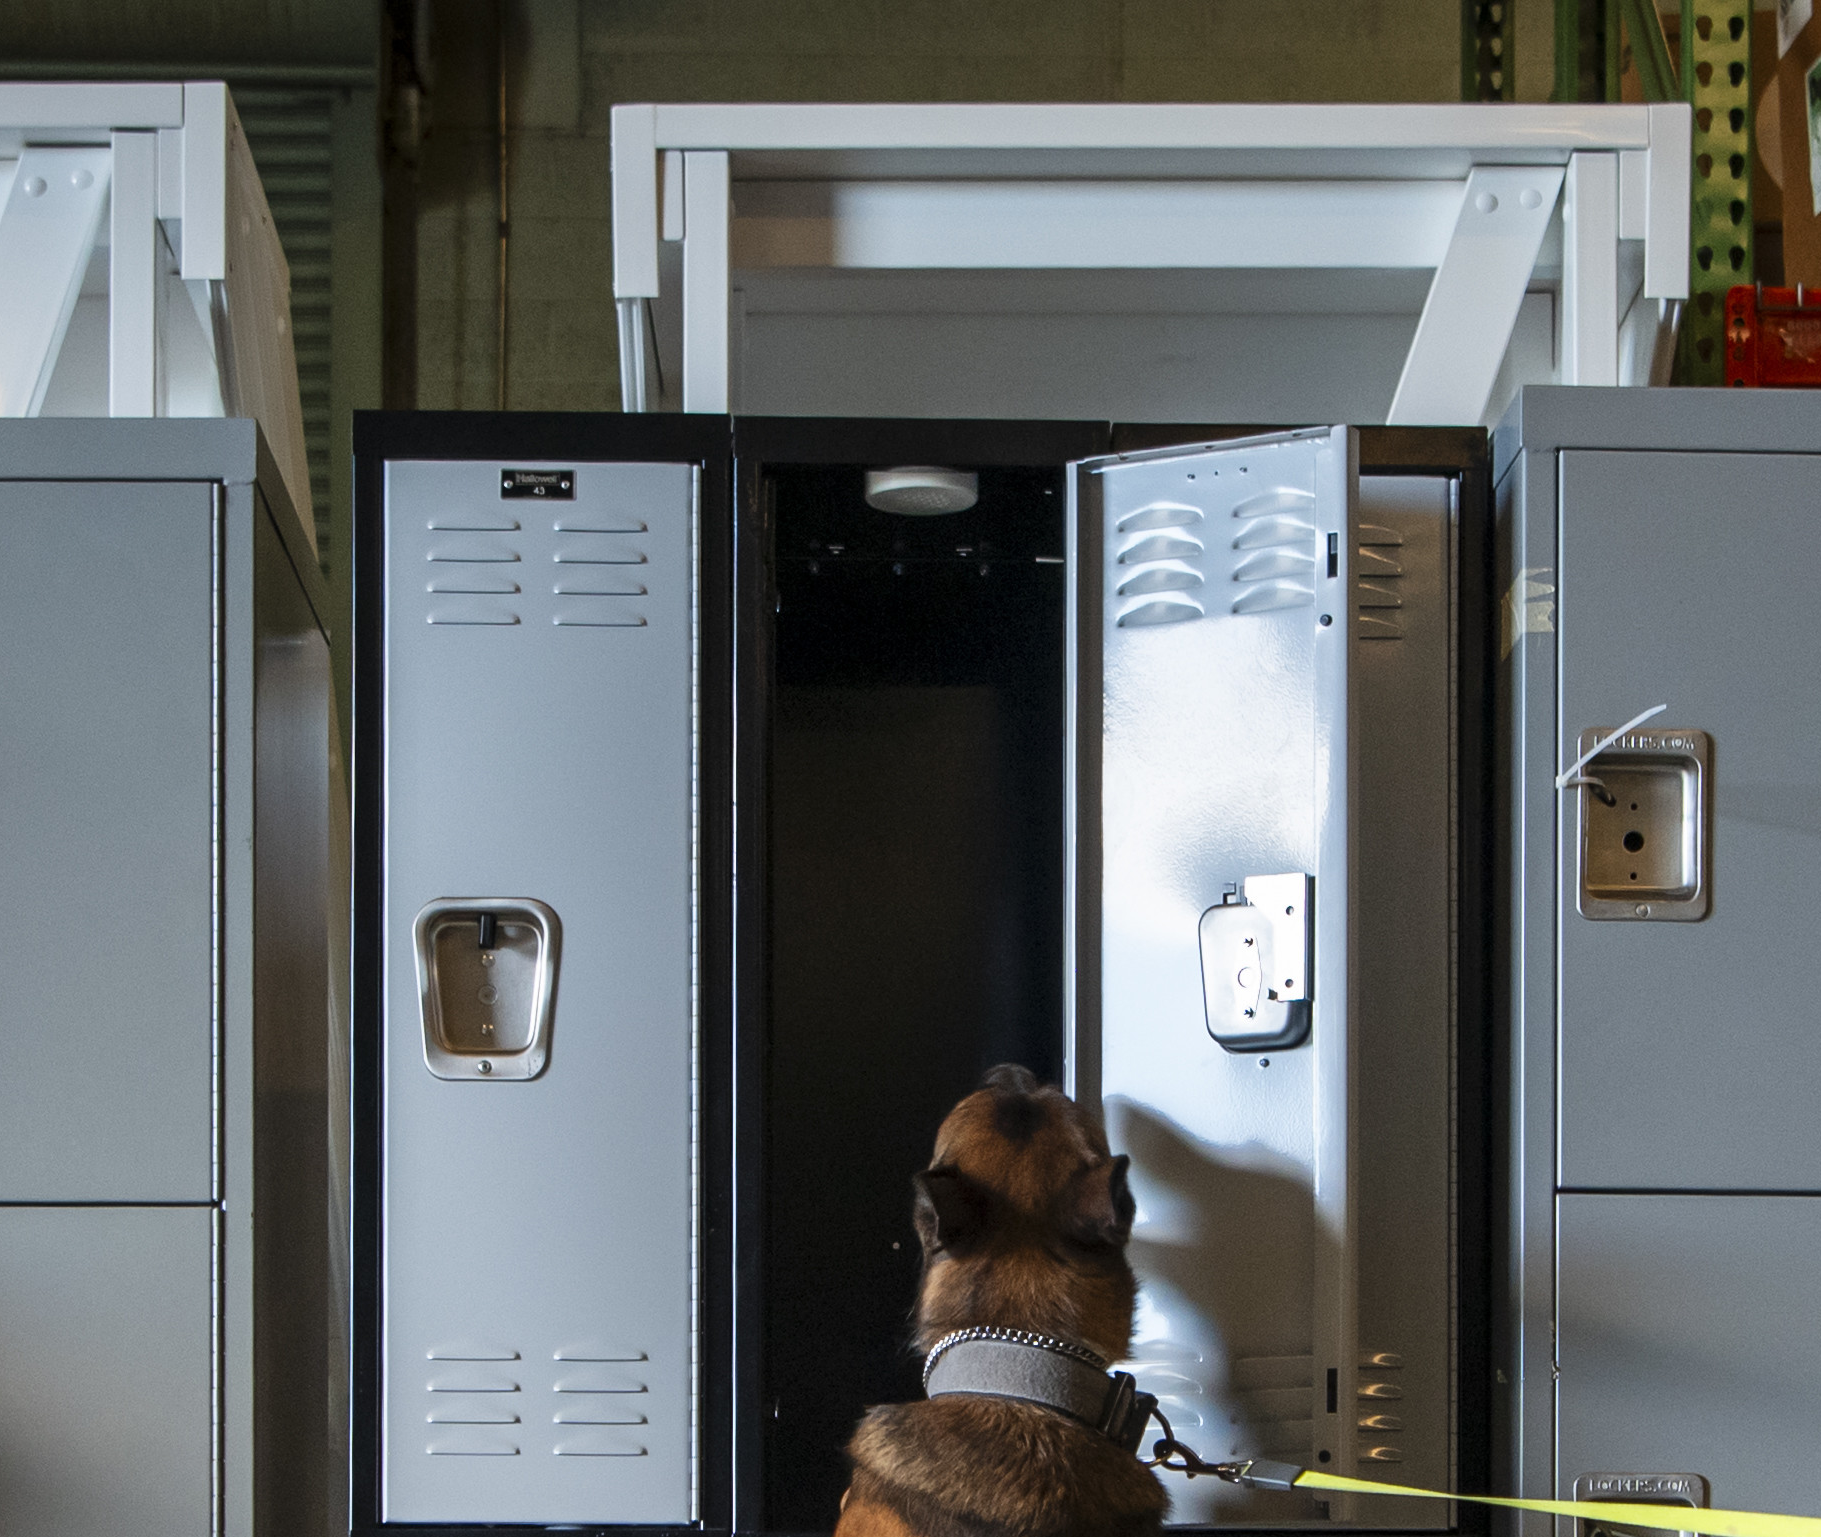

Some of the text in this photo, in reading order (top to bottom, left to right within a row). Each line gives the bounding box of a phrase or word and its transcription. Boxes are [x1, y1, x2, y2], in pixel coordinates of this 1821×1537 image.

[533, 486, 545, 495] 43
[1593, 735, 1694, 750] LCKERS.COM
[1589, 1479, 1691, 1493] LOCKERS.COM
